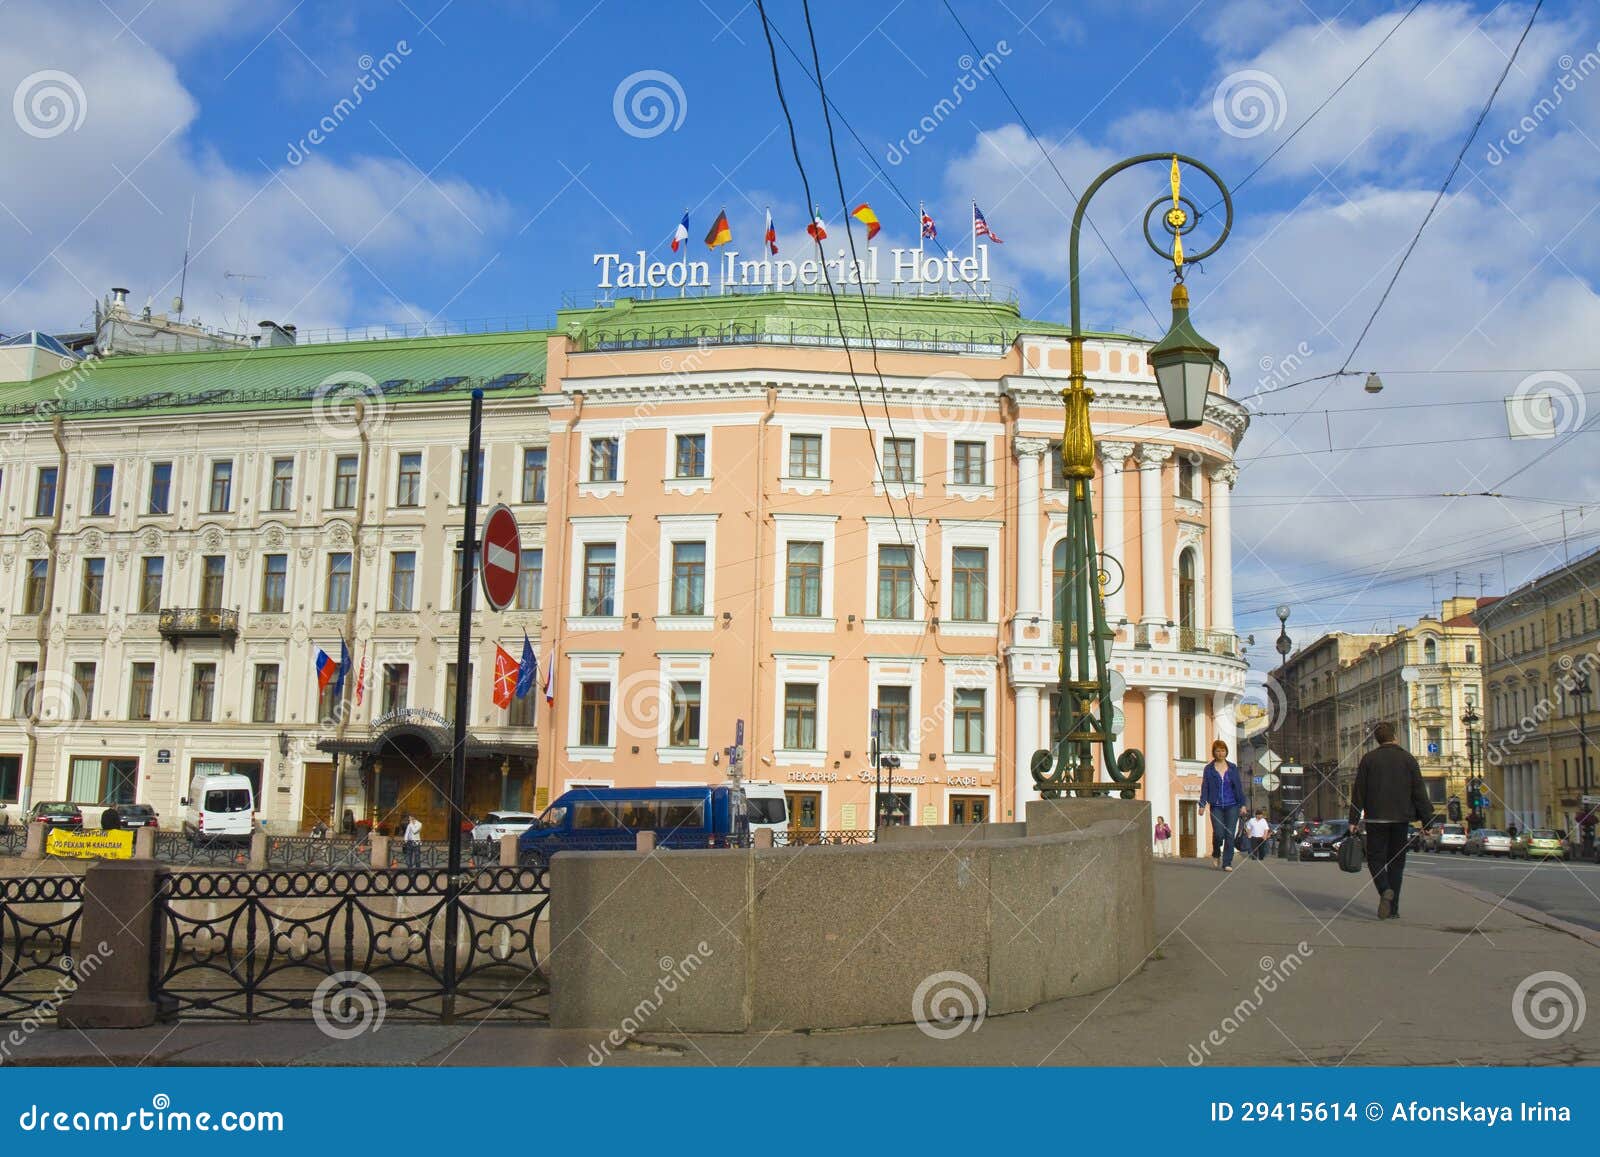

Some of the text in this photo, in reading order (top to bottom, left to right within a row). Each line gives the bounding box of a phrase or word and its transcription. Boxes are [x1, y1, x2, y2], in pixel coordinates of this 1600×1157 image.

[593, 244, 991, 293] Taleon Imperial Hotel
[786, 770, 838, 784] ПЕКАРНЯ
[946, 775, 977, 788] КАФЕ
